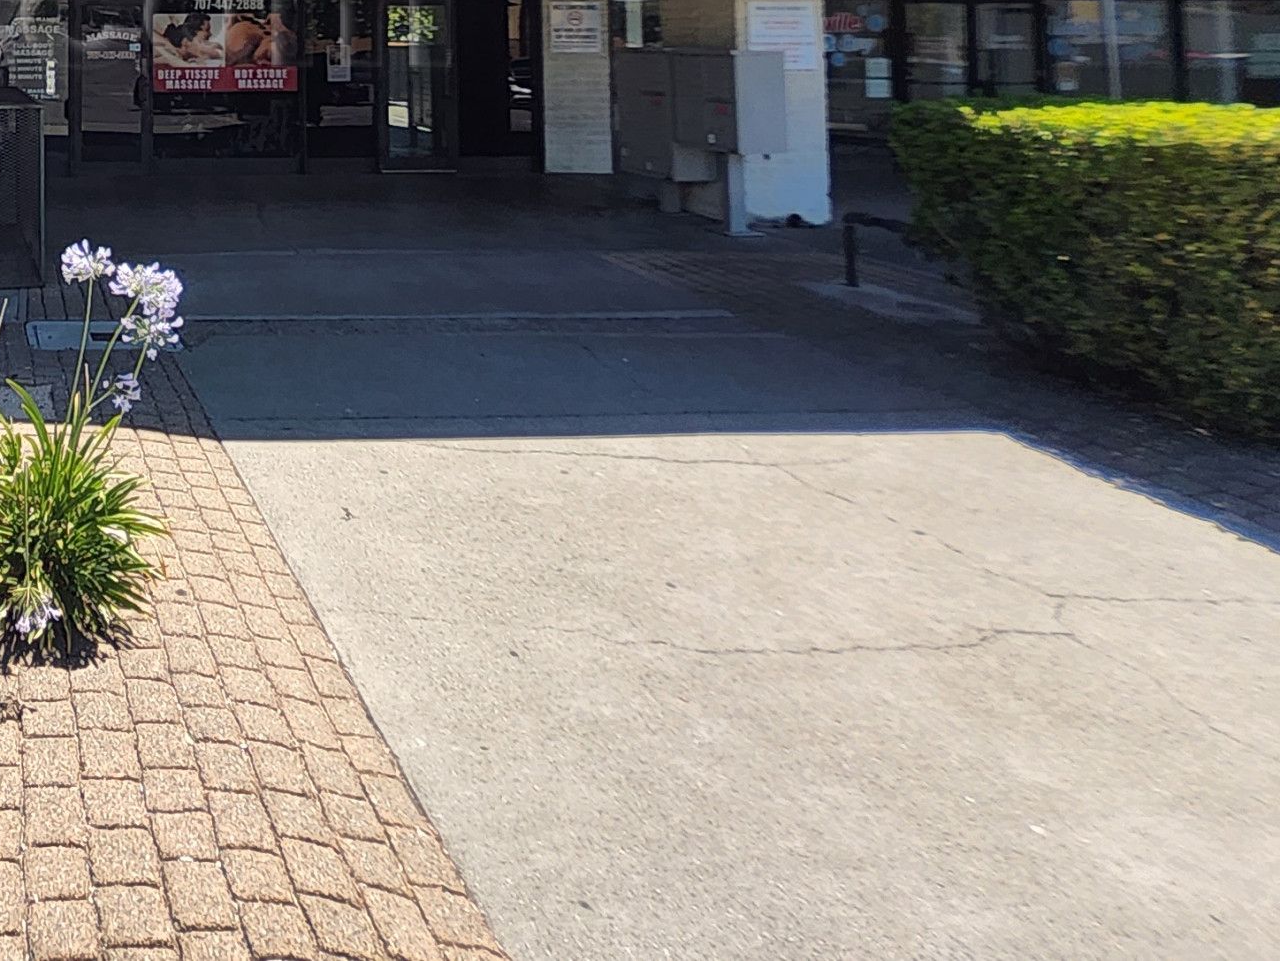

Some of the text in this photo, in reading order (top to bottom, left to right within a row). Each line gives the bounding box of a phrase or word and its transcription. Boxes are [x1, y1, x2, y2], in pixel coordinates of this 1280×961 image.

[4, 24, 61, 34] MASSAGE
[86, 31, 138, 43] MASSAGE
[157, 69, 220, 80] DEEP TISSUE
[165, 80, 212, 89] MASSAGE
[238, 79, 284, 89] MASSAGE
